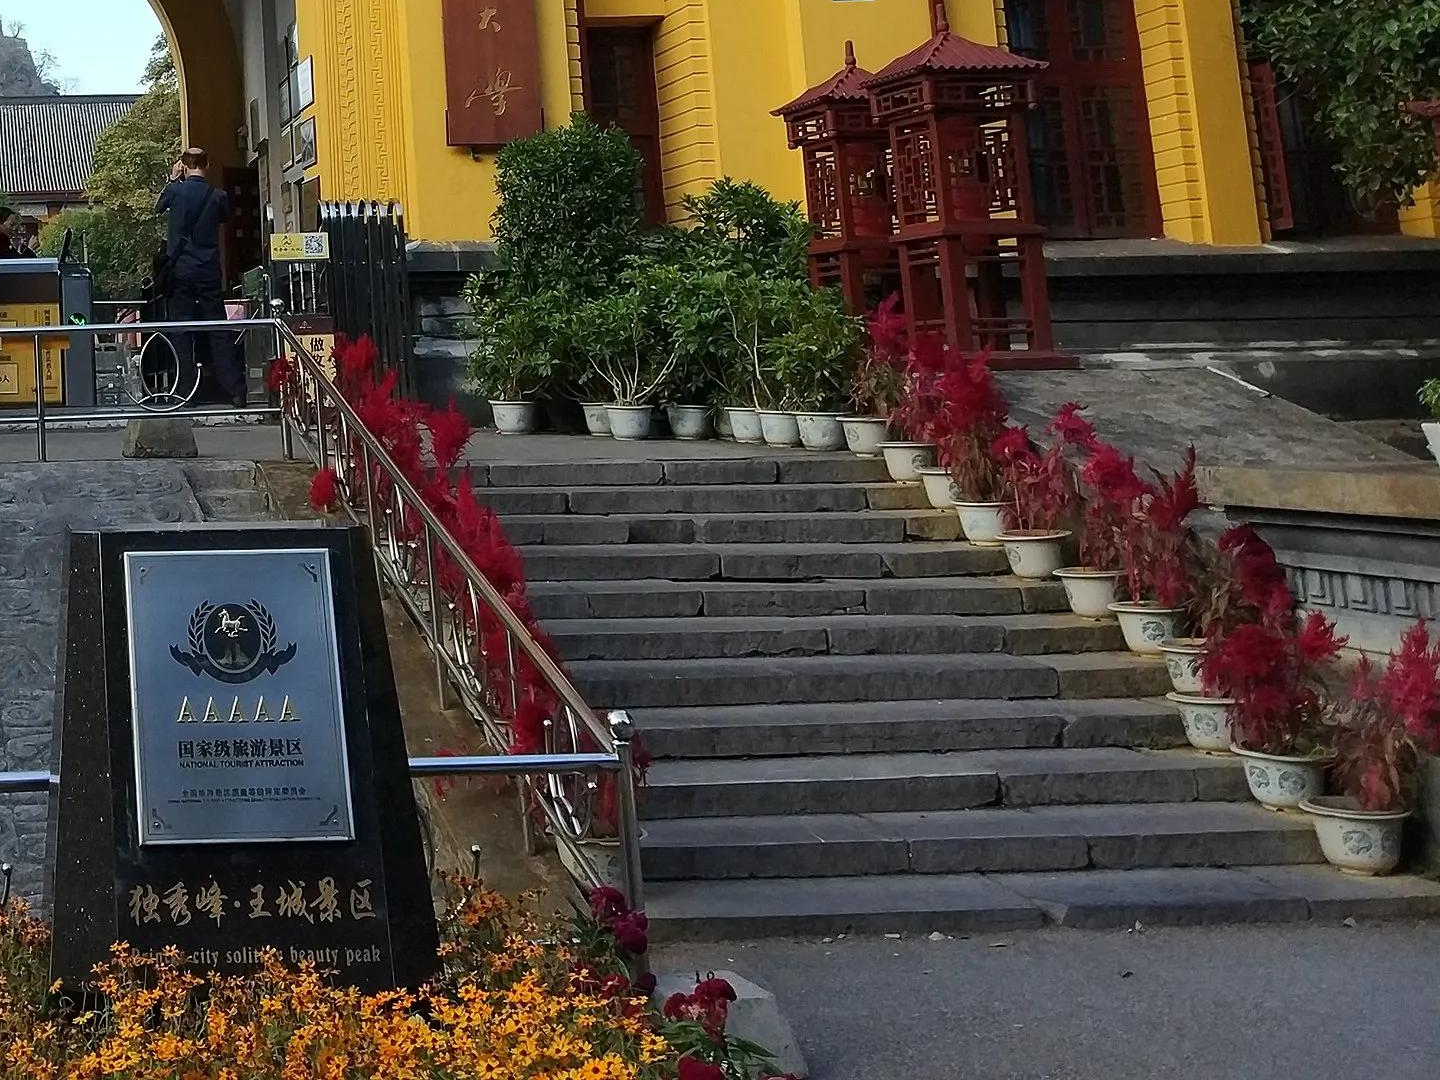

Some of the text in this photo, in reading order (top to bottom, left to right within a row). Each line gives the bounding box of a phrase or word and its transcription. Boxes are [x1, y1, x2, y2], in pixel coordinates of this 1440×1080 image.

[177, 738, 304, 758] 国家级旅游景区
[179, 759, 304, 769] NATIONAL TOURIST ATTRACTION
[192, 947, 219, 967] city
[290, 945, 339, 966] beauty
[345, 944, 381, 966] peak
